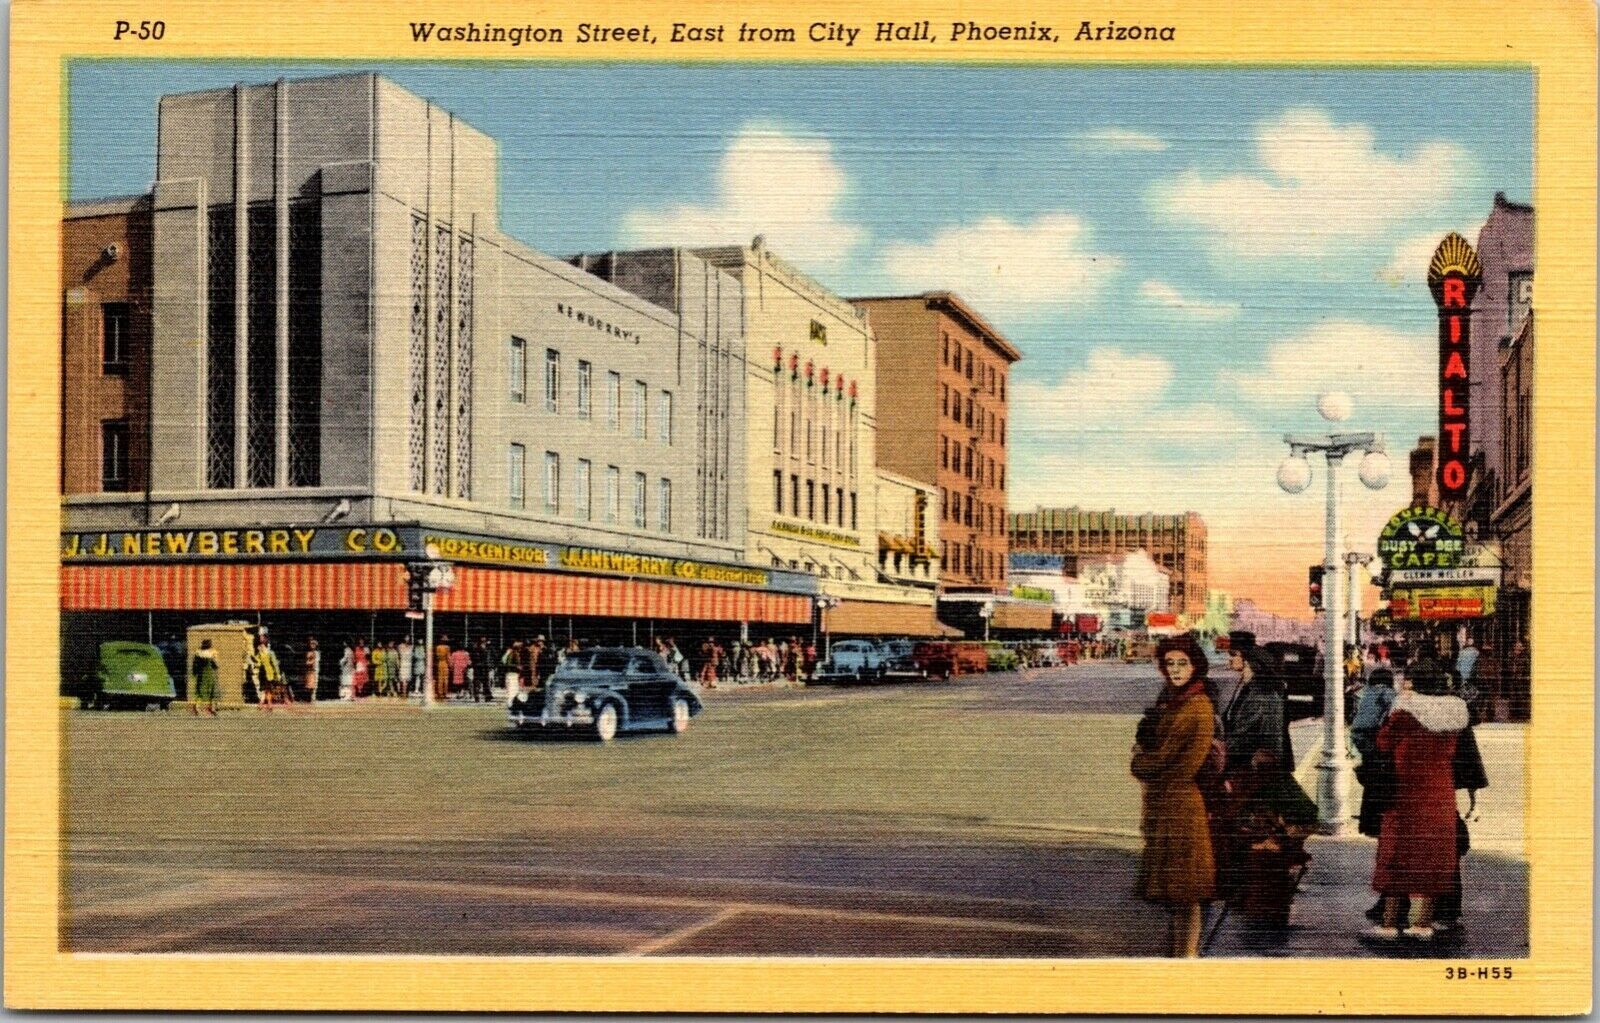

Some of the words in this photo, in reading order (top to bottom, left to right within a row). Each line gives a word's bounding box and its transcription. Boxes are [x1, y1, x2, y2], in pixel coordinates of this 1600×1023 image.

[1443, 278, 1467, 489] RIALTO
[123, 529, 315, 555] NEWBERRY
[347, 528, 403, 552] CO.
[1391, 553, 1451, 567] CAFE
